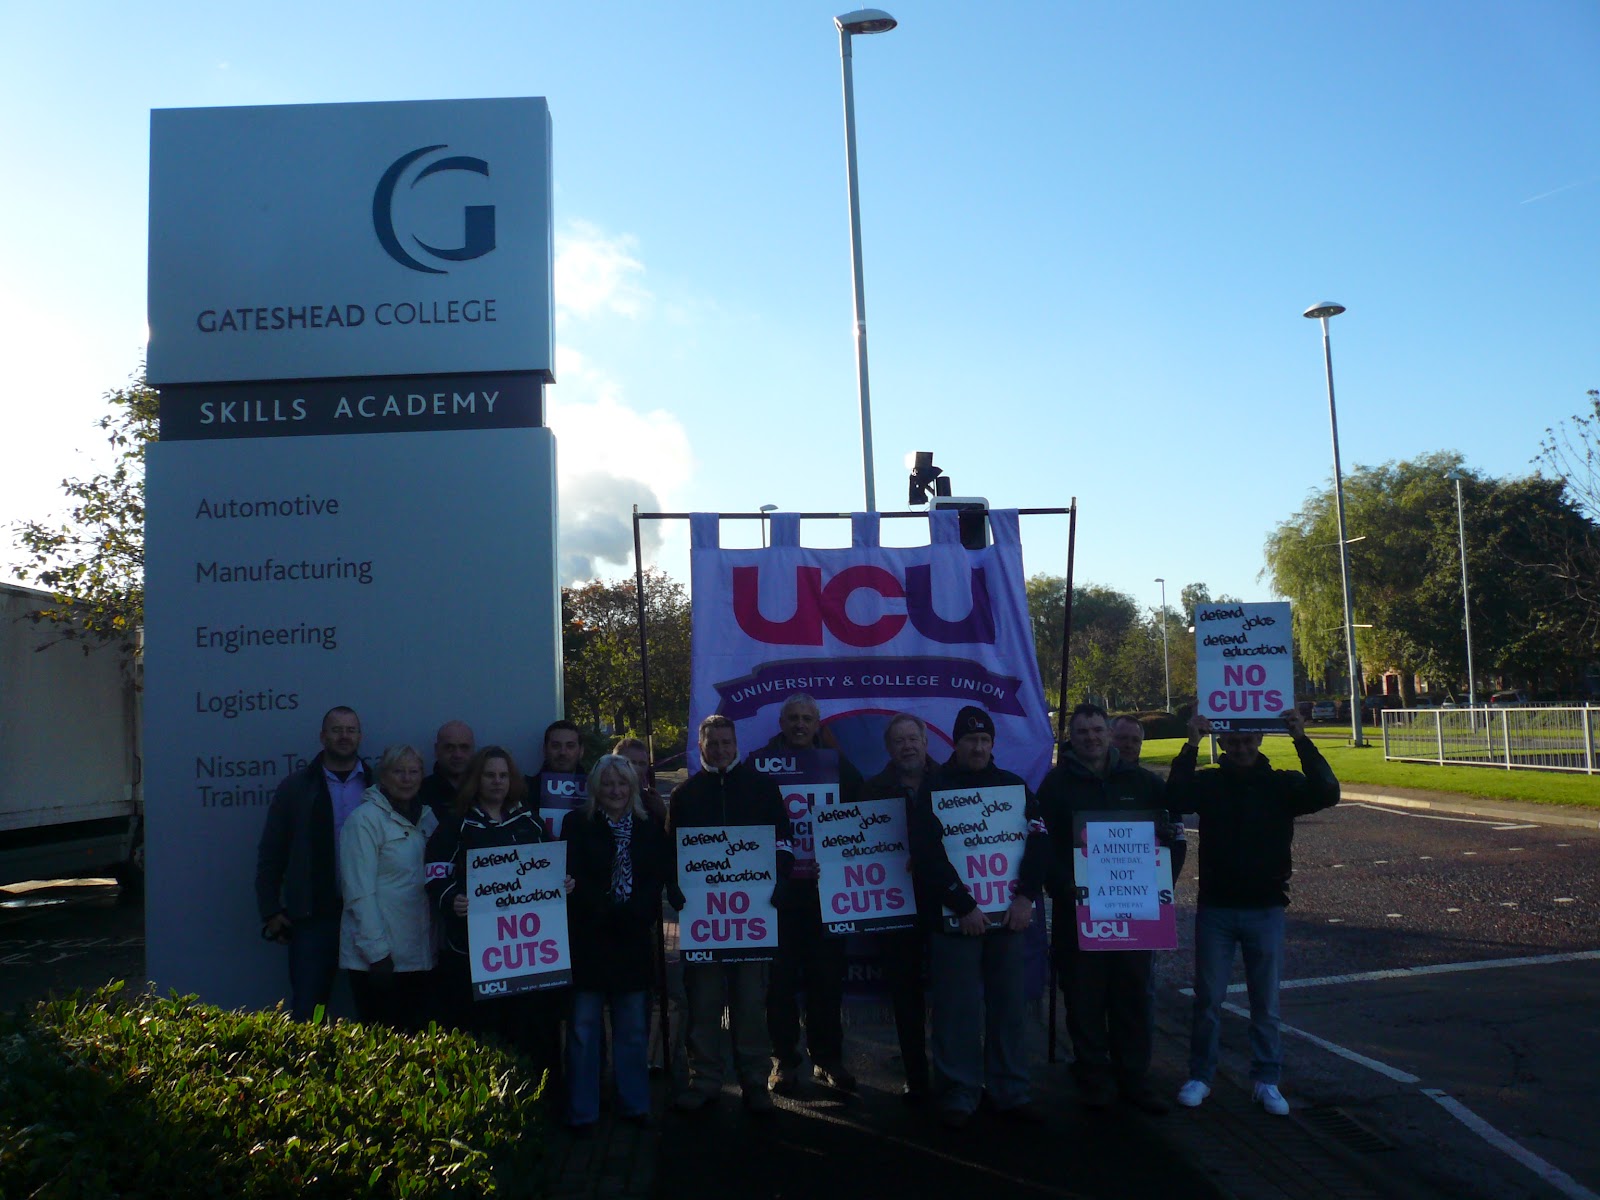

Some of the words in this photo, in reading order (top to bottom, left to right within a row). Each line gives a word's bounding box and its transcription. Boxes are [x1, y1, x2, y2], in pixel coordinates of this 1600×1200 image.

[196, 305, 365, 333] GATESHEAD
[374, 299, 497, 326] COLLEGE
[200, 398, 307, 424] SKILLS
[334, 391, 500, 419] ACADEMY
[196, 494, 339, 519] Automotive
[196, 558, 373, 584] Manufacturing
[1200, 607, 1244, 621] defend
[1242, 615, 1275, 630] jobs
[196, 624, 337, 653] Engineering
[1203, 633, 1248, 646] defend
[1223, 644, 1288, 657] education
[1224, 664, 1266, 686] NO
[731, 676, 836, 702] UNIVERSITY
[842, 675, 855, 687] &
[861, 674, 939, 687] COLLEGE
[951, 677, 1006, 700] UNION
[196, 689, 299, 718] Logistics
[1208, 690, 1284, 712] CUTS
[196, 755, 276, 778] Nissan
[938, 792, 983, 810] defend
[982, 800, 1012, 817] jobs
[817, 806, 861, 825] defend
[859, 813, 891, 829] jobs
[942, 819, 988, 837] defend
[1108, 828, 1133, 838] NOT
[682, 831, 728, 846] defend
[725, 839, 760, 855] jobs
[822, 832, 865, 848] defend
[964, 831, 1025, 847] education
[842, 841, 904, 857] education
[1092, 844, 1100, 854] A
[1103, 843, 1150, 854] MINUTE
[472, 849, 519, 869] defend
[516, 857, 550, 875] jobs
[685, 858, 731, 873] defend
[966, 853, 1008, 878] NO
[706, 869, 772, 884] education
[844, 863, 886, 887] NO
[1110, 870, 1135, 880] NOT
[475, 878, 521, 897] defend
[963, 879, 1020, 906] UTS
[1097, 886, 1106, 896] A
[1109, 885, 1149, 896] PENNY
[496, 888, 561, 908] education
[706, 891, 750, 915] NO
[832, 887, 905, 914] CUTS
[497, 912, 541, 940] NO
[690, 917, 767, 942] CUTS
[482, 939, 559, 972] CUTS
